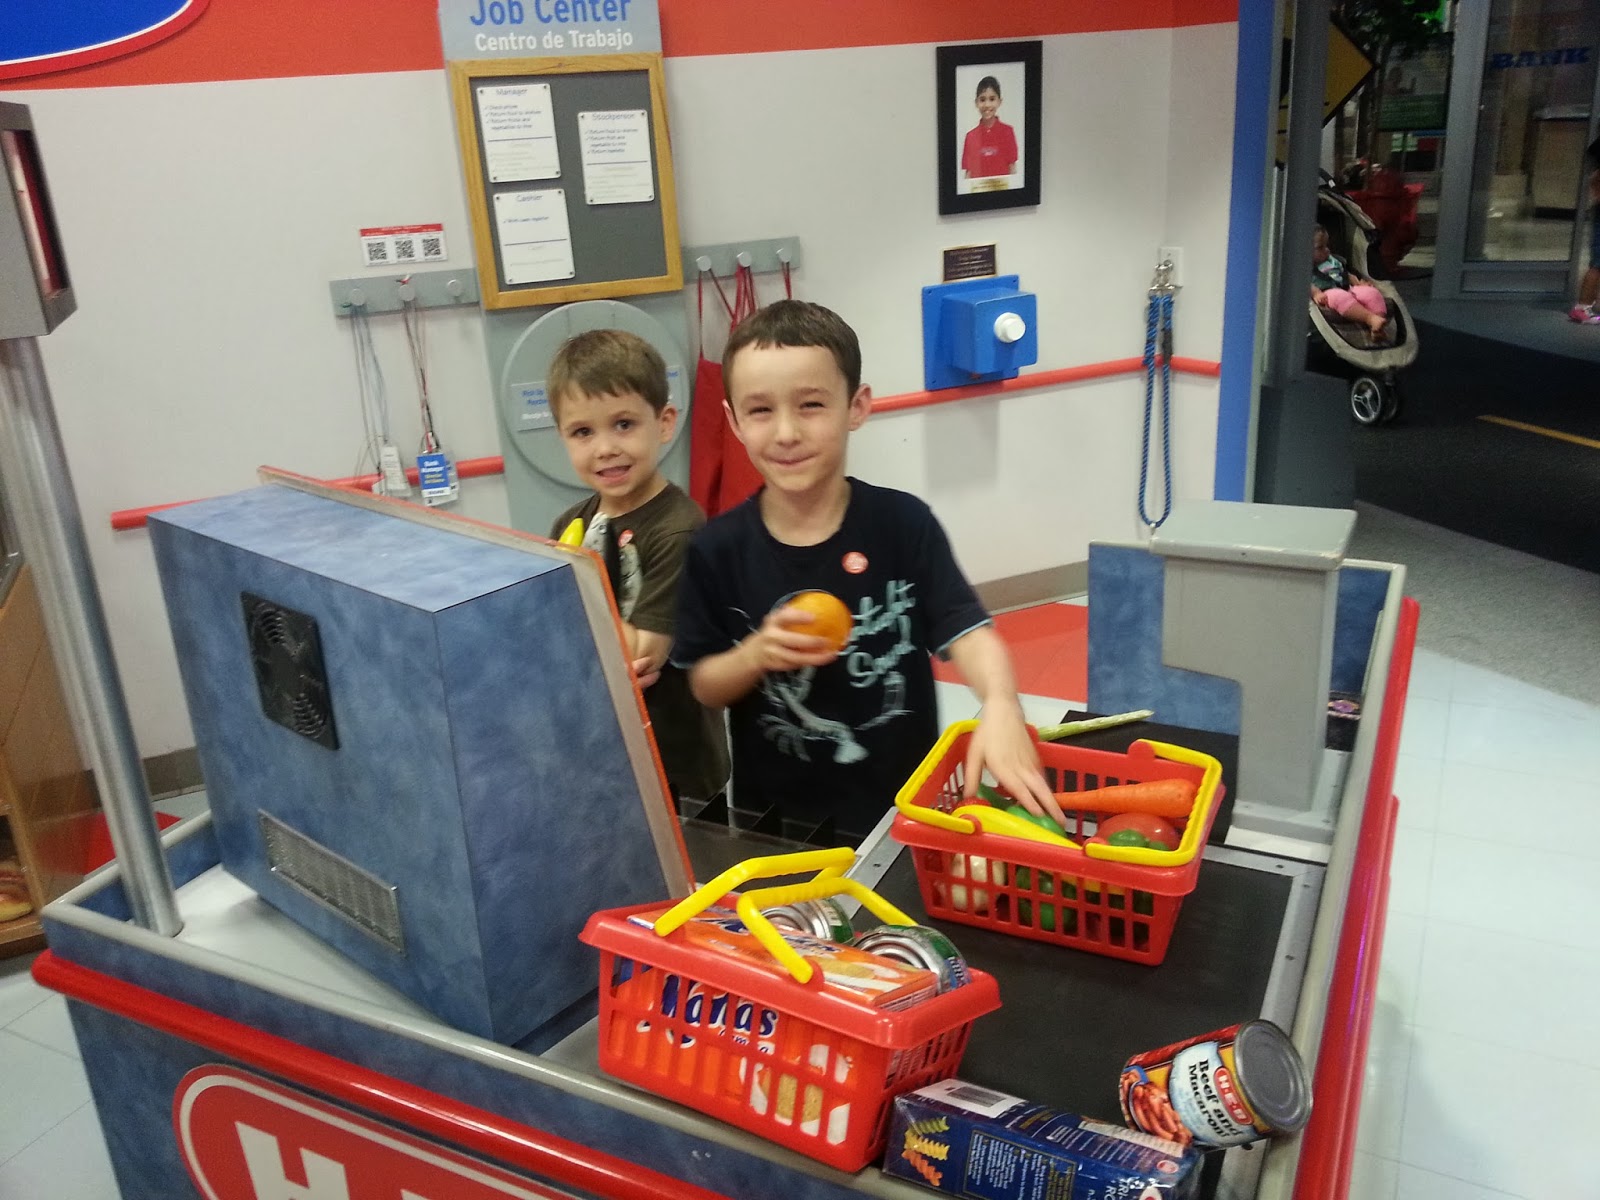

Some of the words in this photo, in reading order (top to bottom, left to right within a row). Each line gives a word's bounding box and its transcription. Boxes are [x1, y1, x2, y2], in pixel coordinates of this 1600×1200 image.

[470, 0, 524, 26] Job
[534, 0, 632, 24] Center
[475, 32, 537, 51] Centro
[542, 31, 564, 49] de
[568, 28, 633, 50] Trabajo
[1187, 1063, 1230, 1138] Macaroni
[1198, 1058, 1220, 1104] Beef
[1212, 1107, 1245, 1137] and
